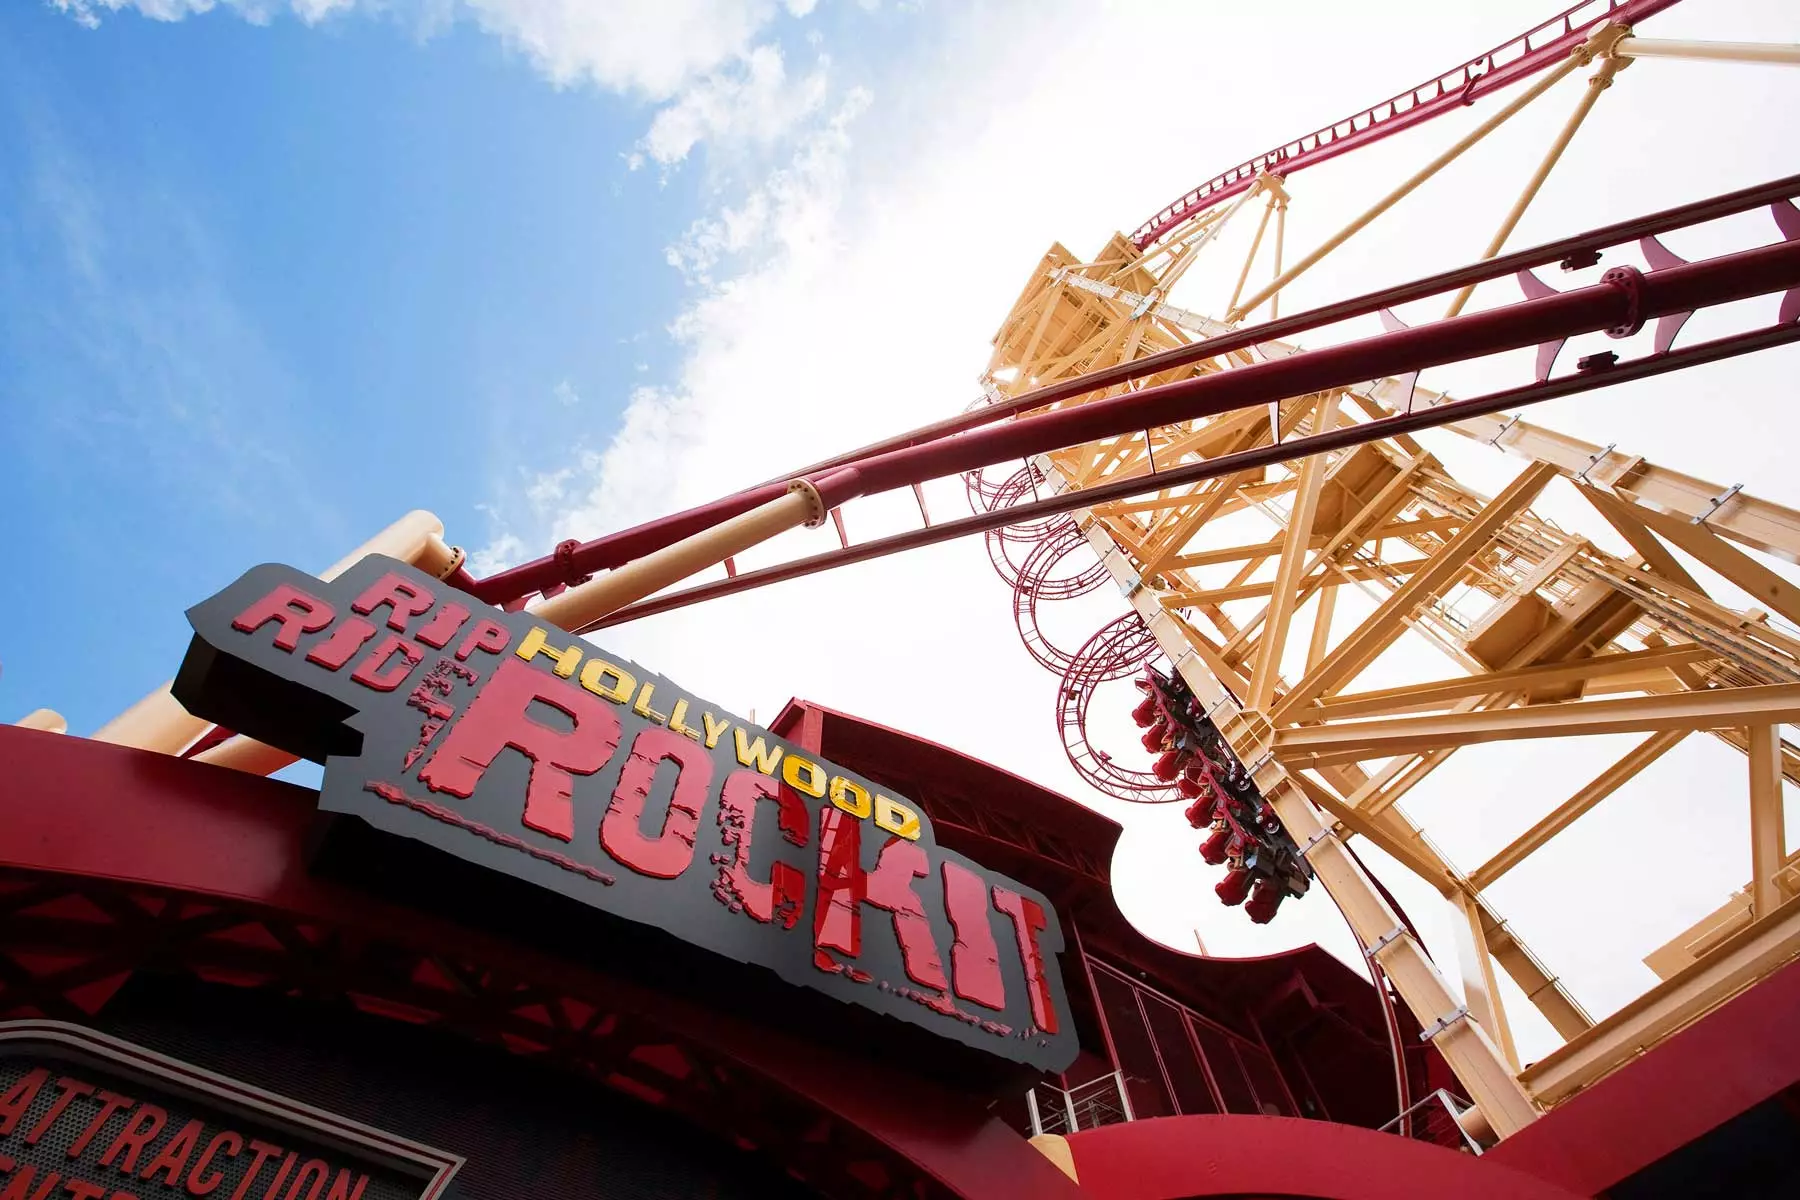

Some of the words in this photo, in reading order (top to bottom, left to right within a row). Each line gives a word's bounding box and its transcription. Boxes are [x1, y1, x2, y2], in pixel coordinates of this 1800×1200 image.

[231, 583, 479, 719] RIDE
[350, 571, 511, 662] RIP
[514, 626, 922, 841] HOLLYWOOD
[417, 655, 1059, 1035] ROCKIT
